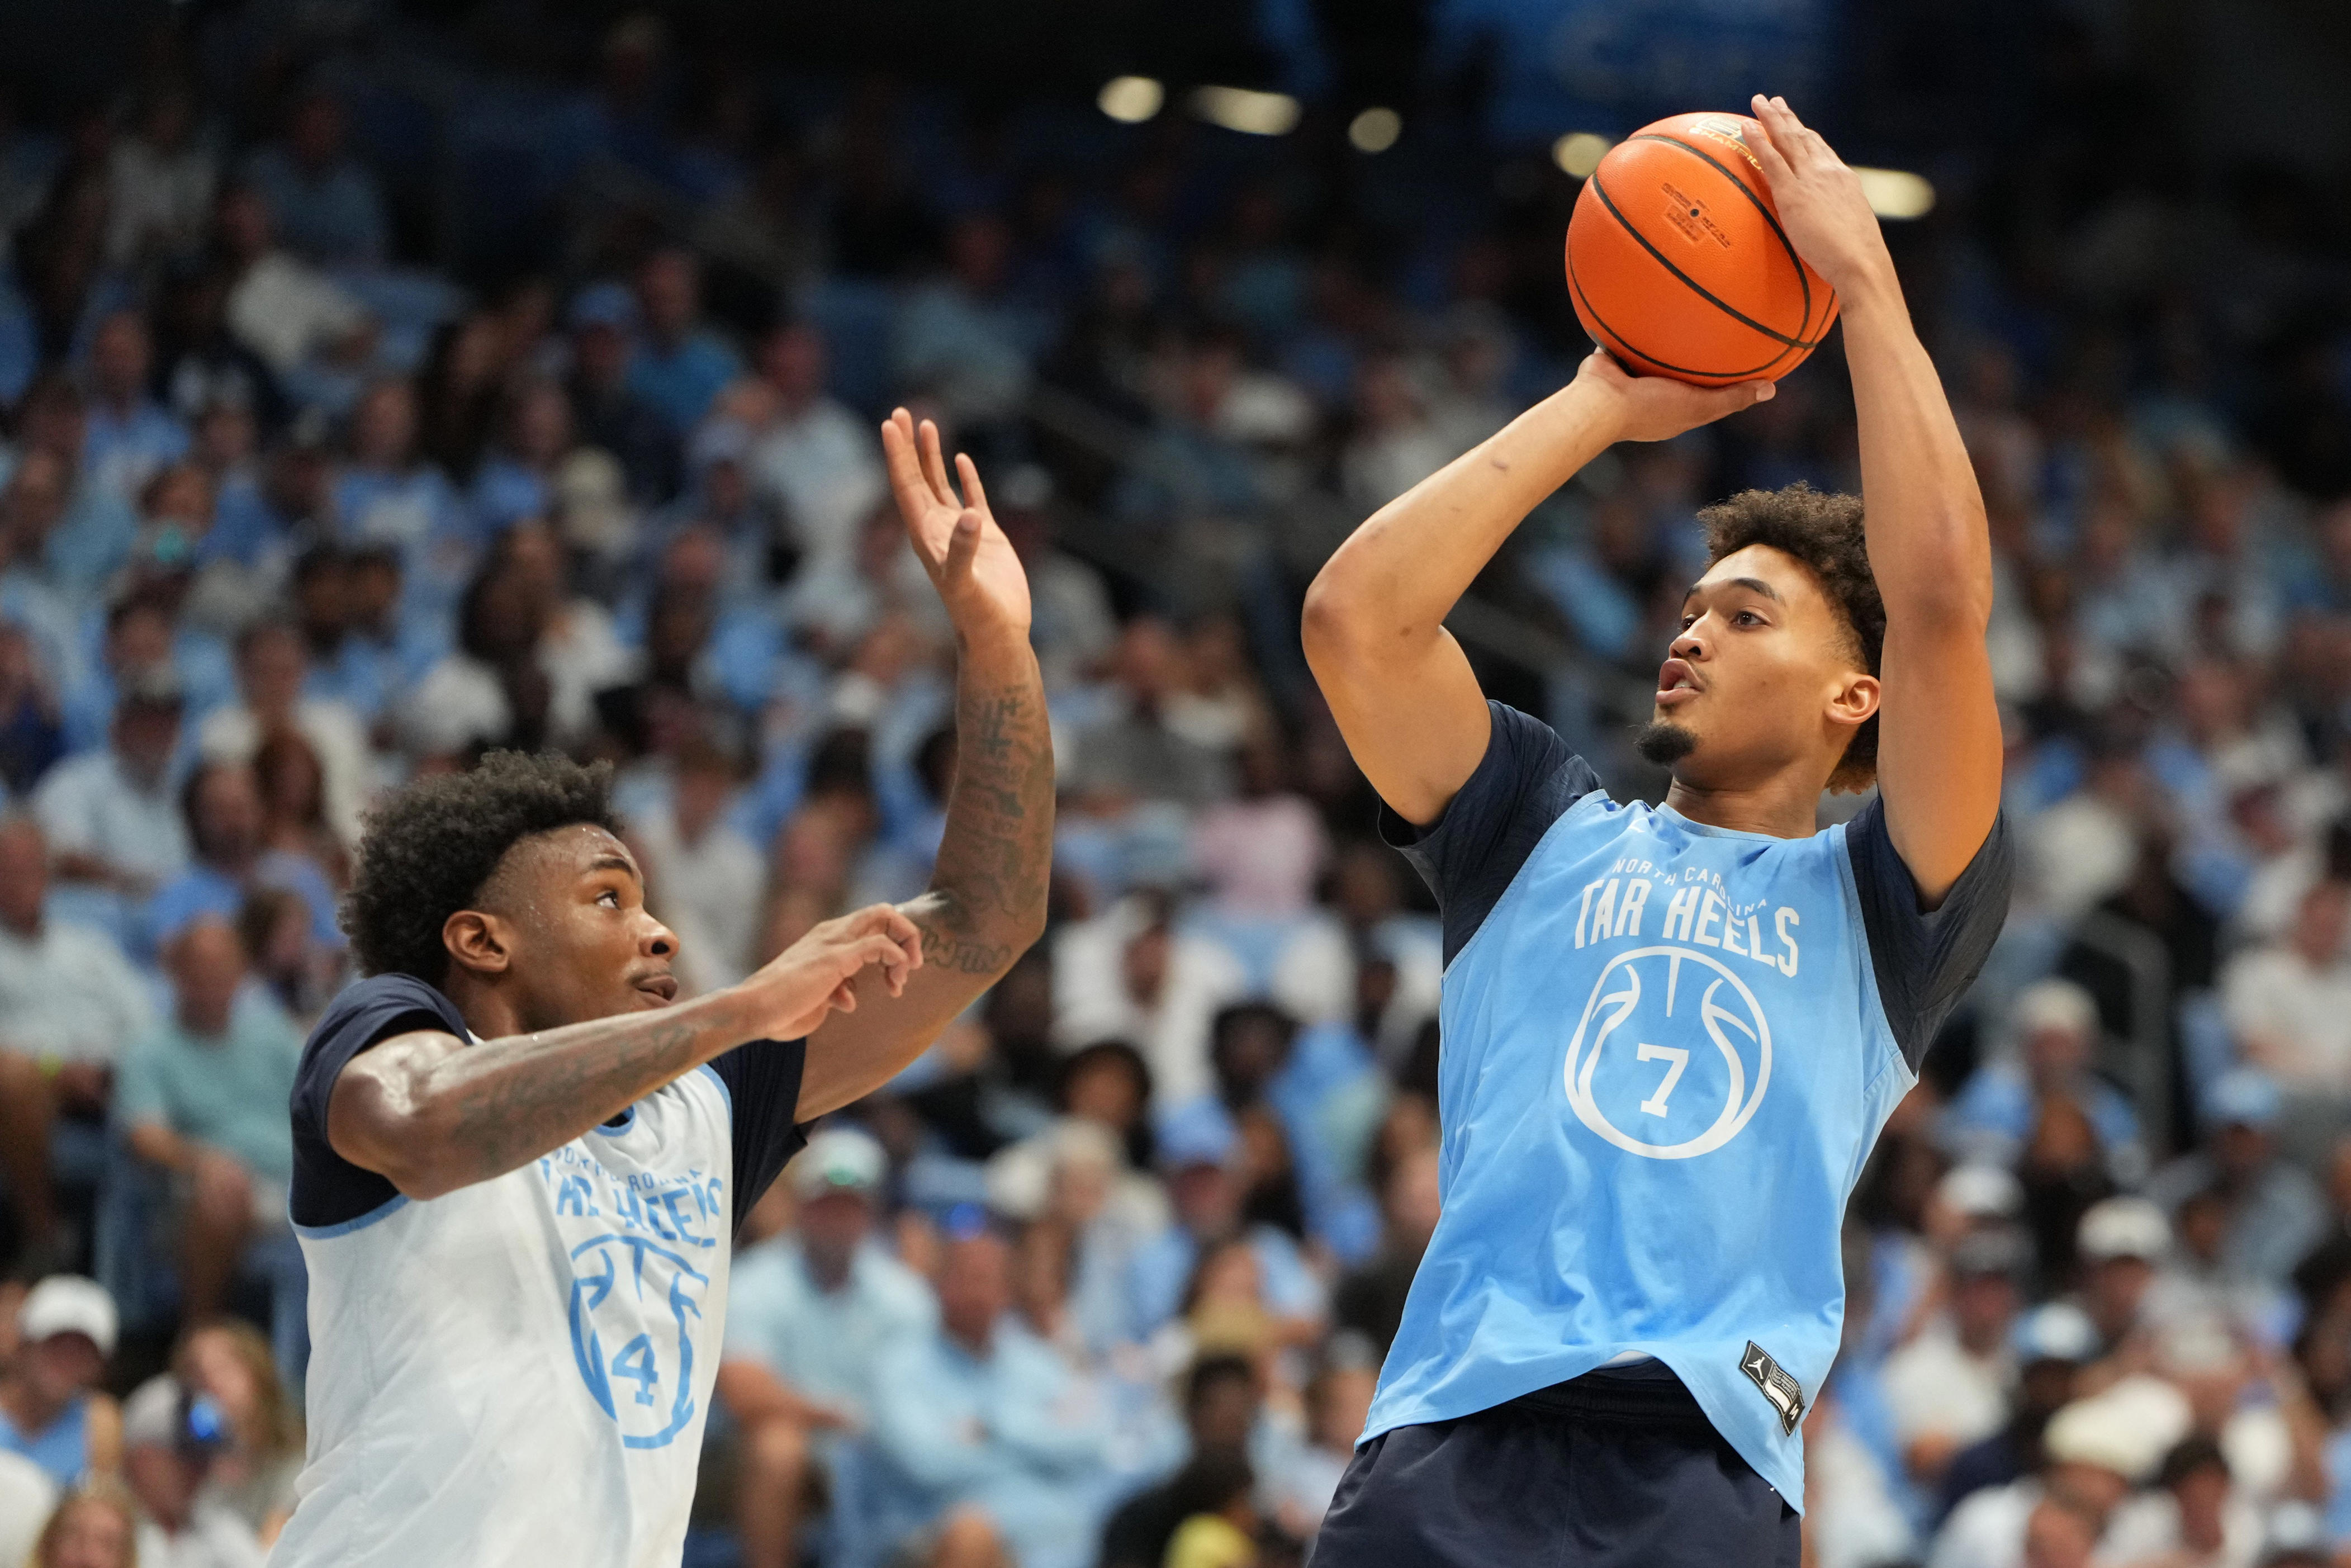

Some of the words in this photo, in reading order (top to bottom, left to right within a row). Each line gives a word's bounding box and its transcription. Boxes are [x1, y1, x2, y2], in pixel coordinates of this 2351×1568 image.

[1689, 126, 1765, 174] CHAMPIO
[1611, 858, 1677, 887] NORTH
[1684, 866, 1767, 917] CAROLINA
[1575, 878, 1652, 950] TAR
[1662, 885, 1800, 979] HEELS
[1636, 1043, 1689, 1119] 7
[612, 1333, 658, 1407] 4
